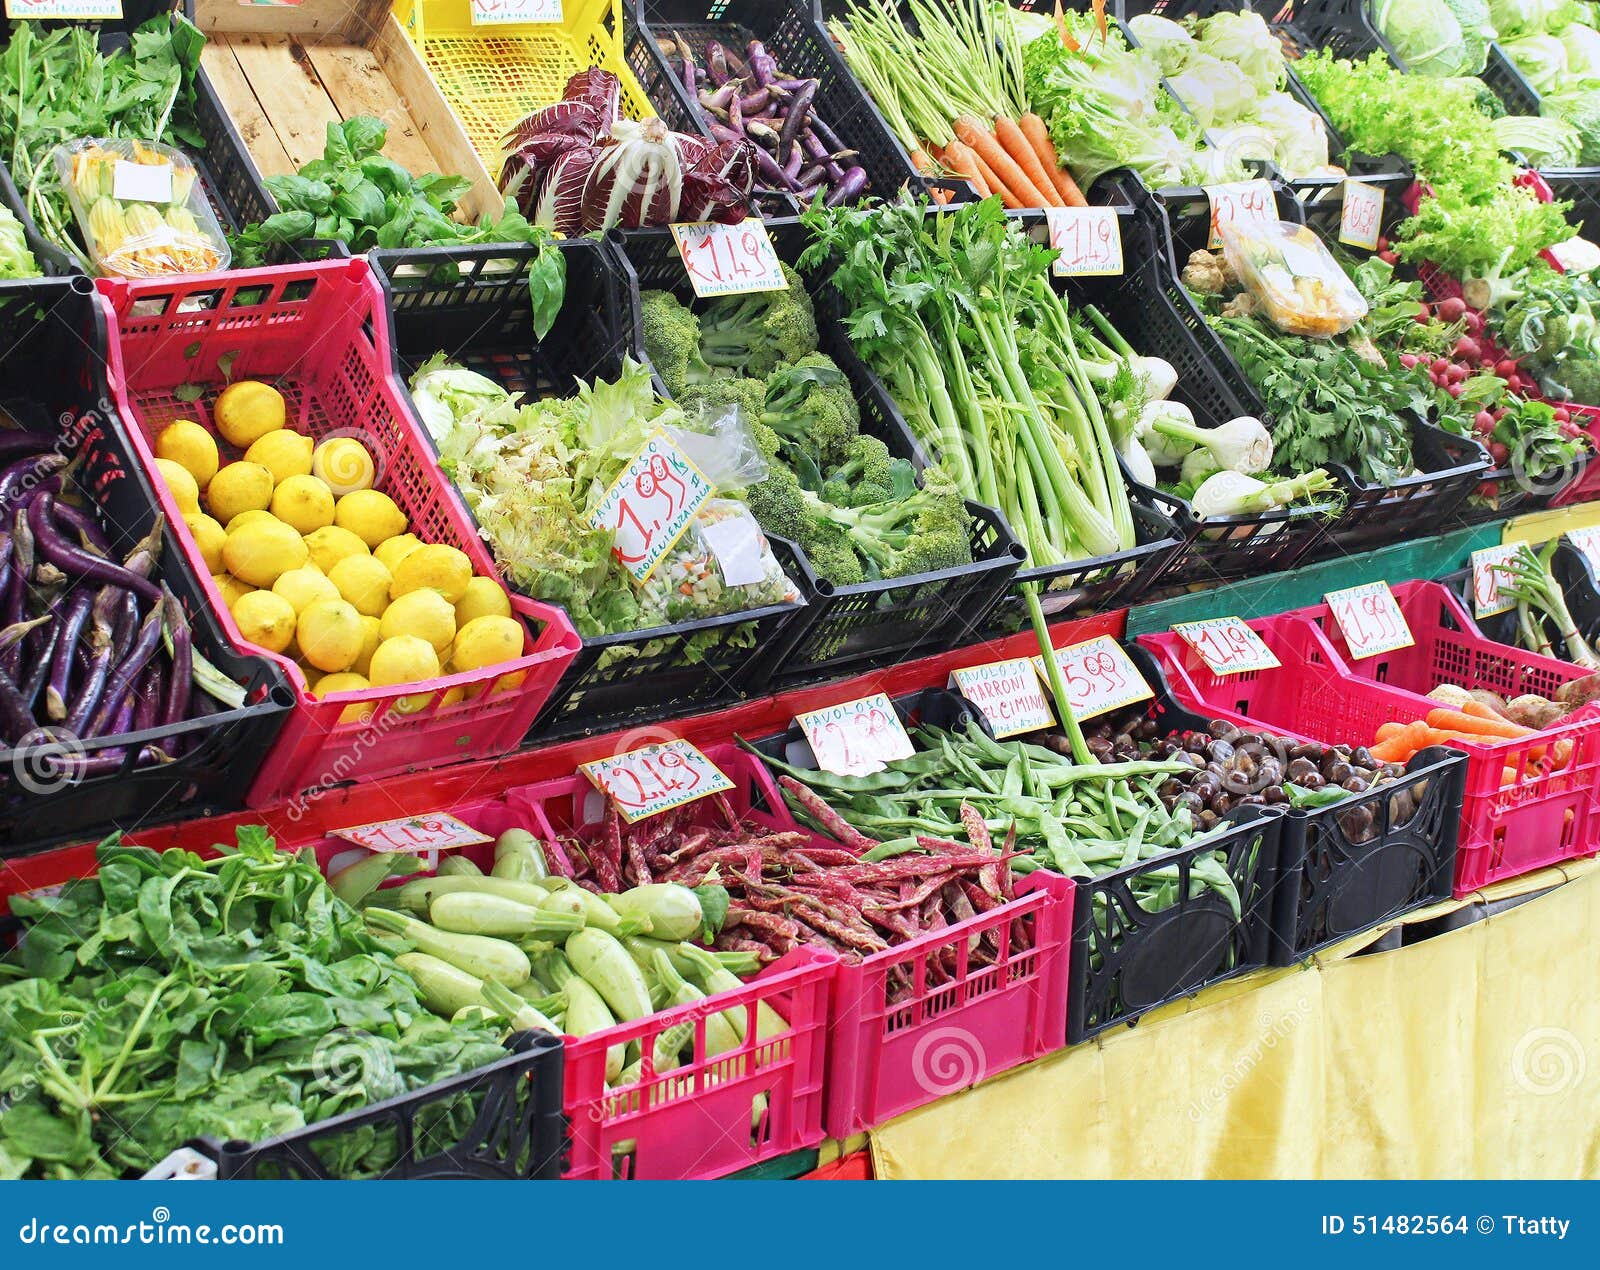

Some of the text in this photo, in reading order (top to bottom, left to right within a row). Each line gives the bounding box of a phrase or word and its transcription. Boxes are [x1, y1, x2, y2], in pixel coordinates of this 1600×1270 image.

[590, 442, 657, 529] FAVOLOSO
[959, 661, 1026, 684] FAVOLOSO
[966, 675, 1025, 701] MARRONI
[805, 697, 884, 728] FAVOLOSO
[1000, 694, 1045, 719] CIMINO
